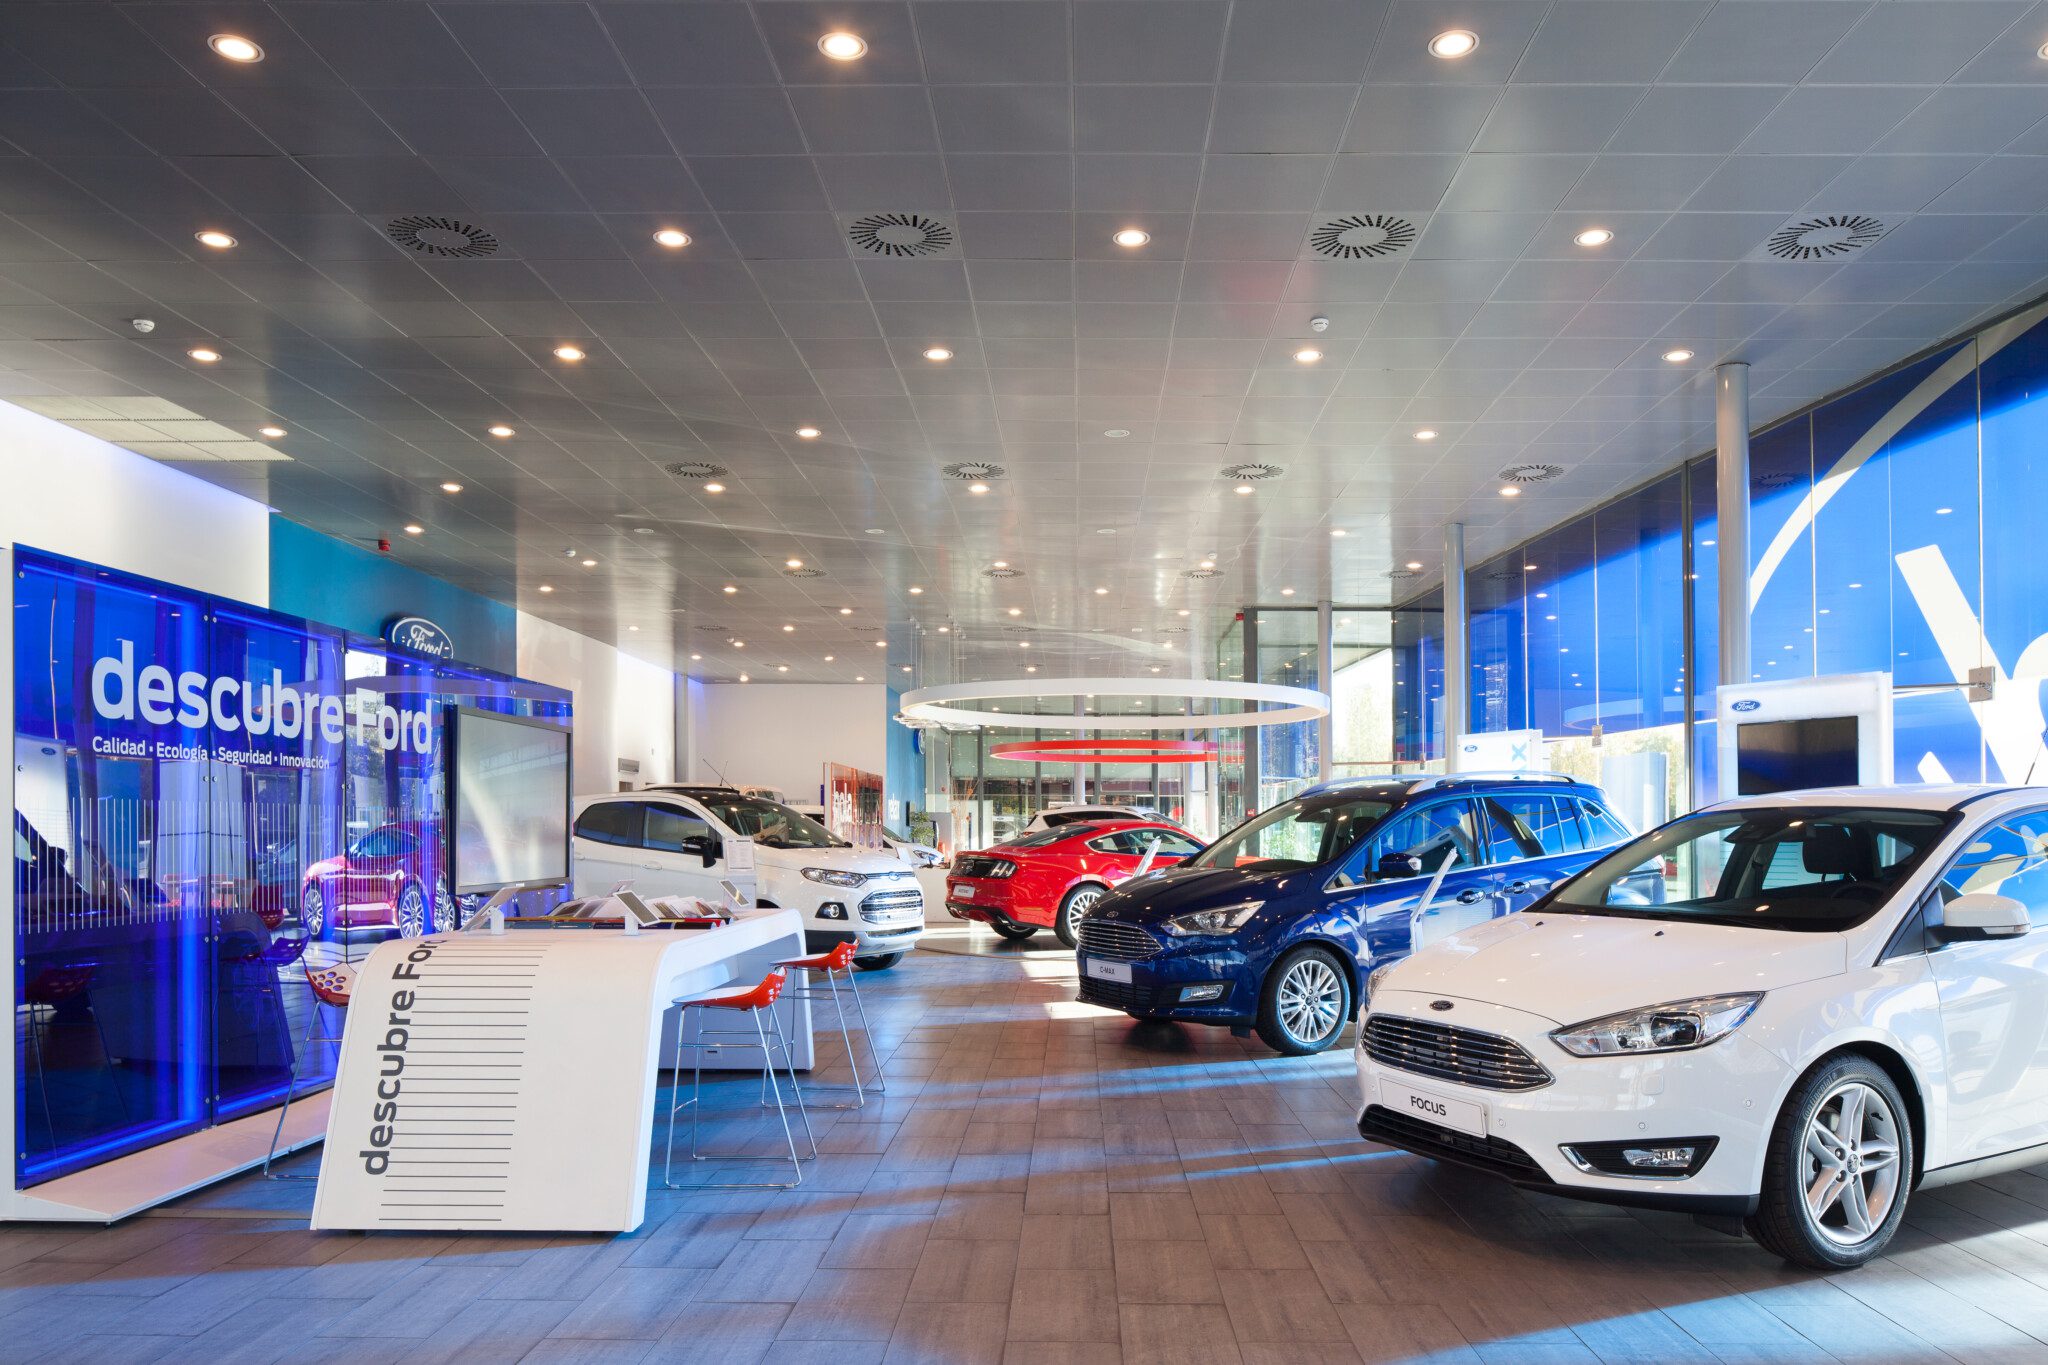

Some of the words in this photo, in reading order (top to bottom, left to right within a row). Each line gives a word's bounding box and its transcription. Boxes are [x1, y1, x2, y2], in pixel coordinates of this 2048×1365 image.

[91, 638, 345, 744] descubre
[356, 686, 432, 755] Ford
[1734, 700, 1758, 711] Ford
[92, 735, 146, 756] Calidad
[156, 742, 208, 762] Ecología
[218, 746, 272, 766] Seguridad
[280, 752, 330, 770] Innovación
[1099, 966, 1115, 975] C-MAX
[359, 990, 415, 1175] descubre
[1410, 1095, 1447, 1117] FOCUS
